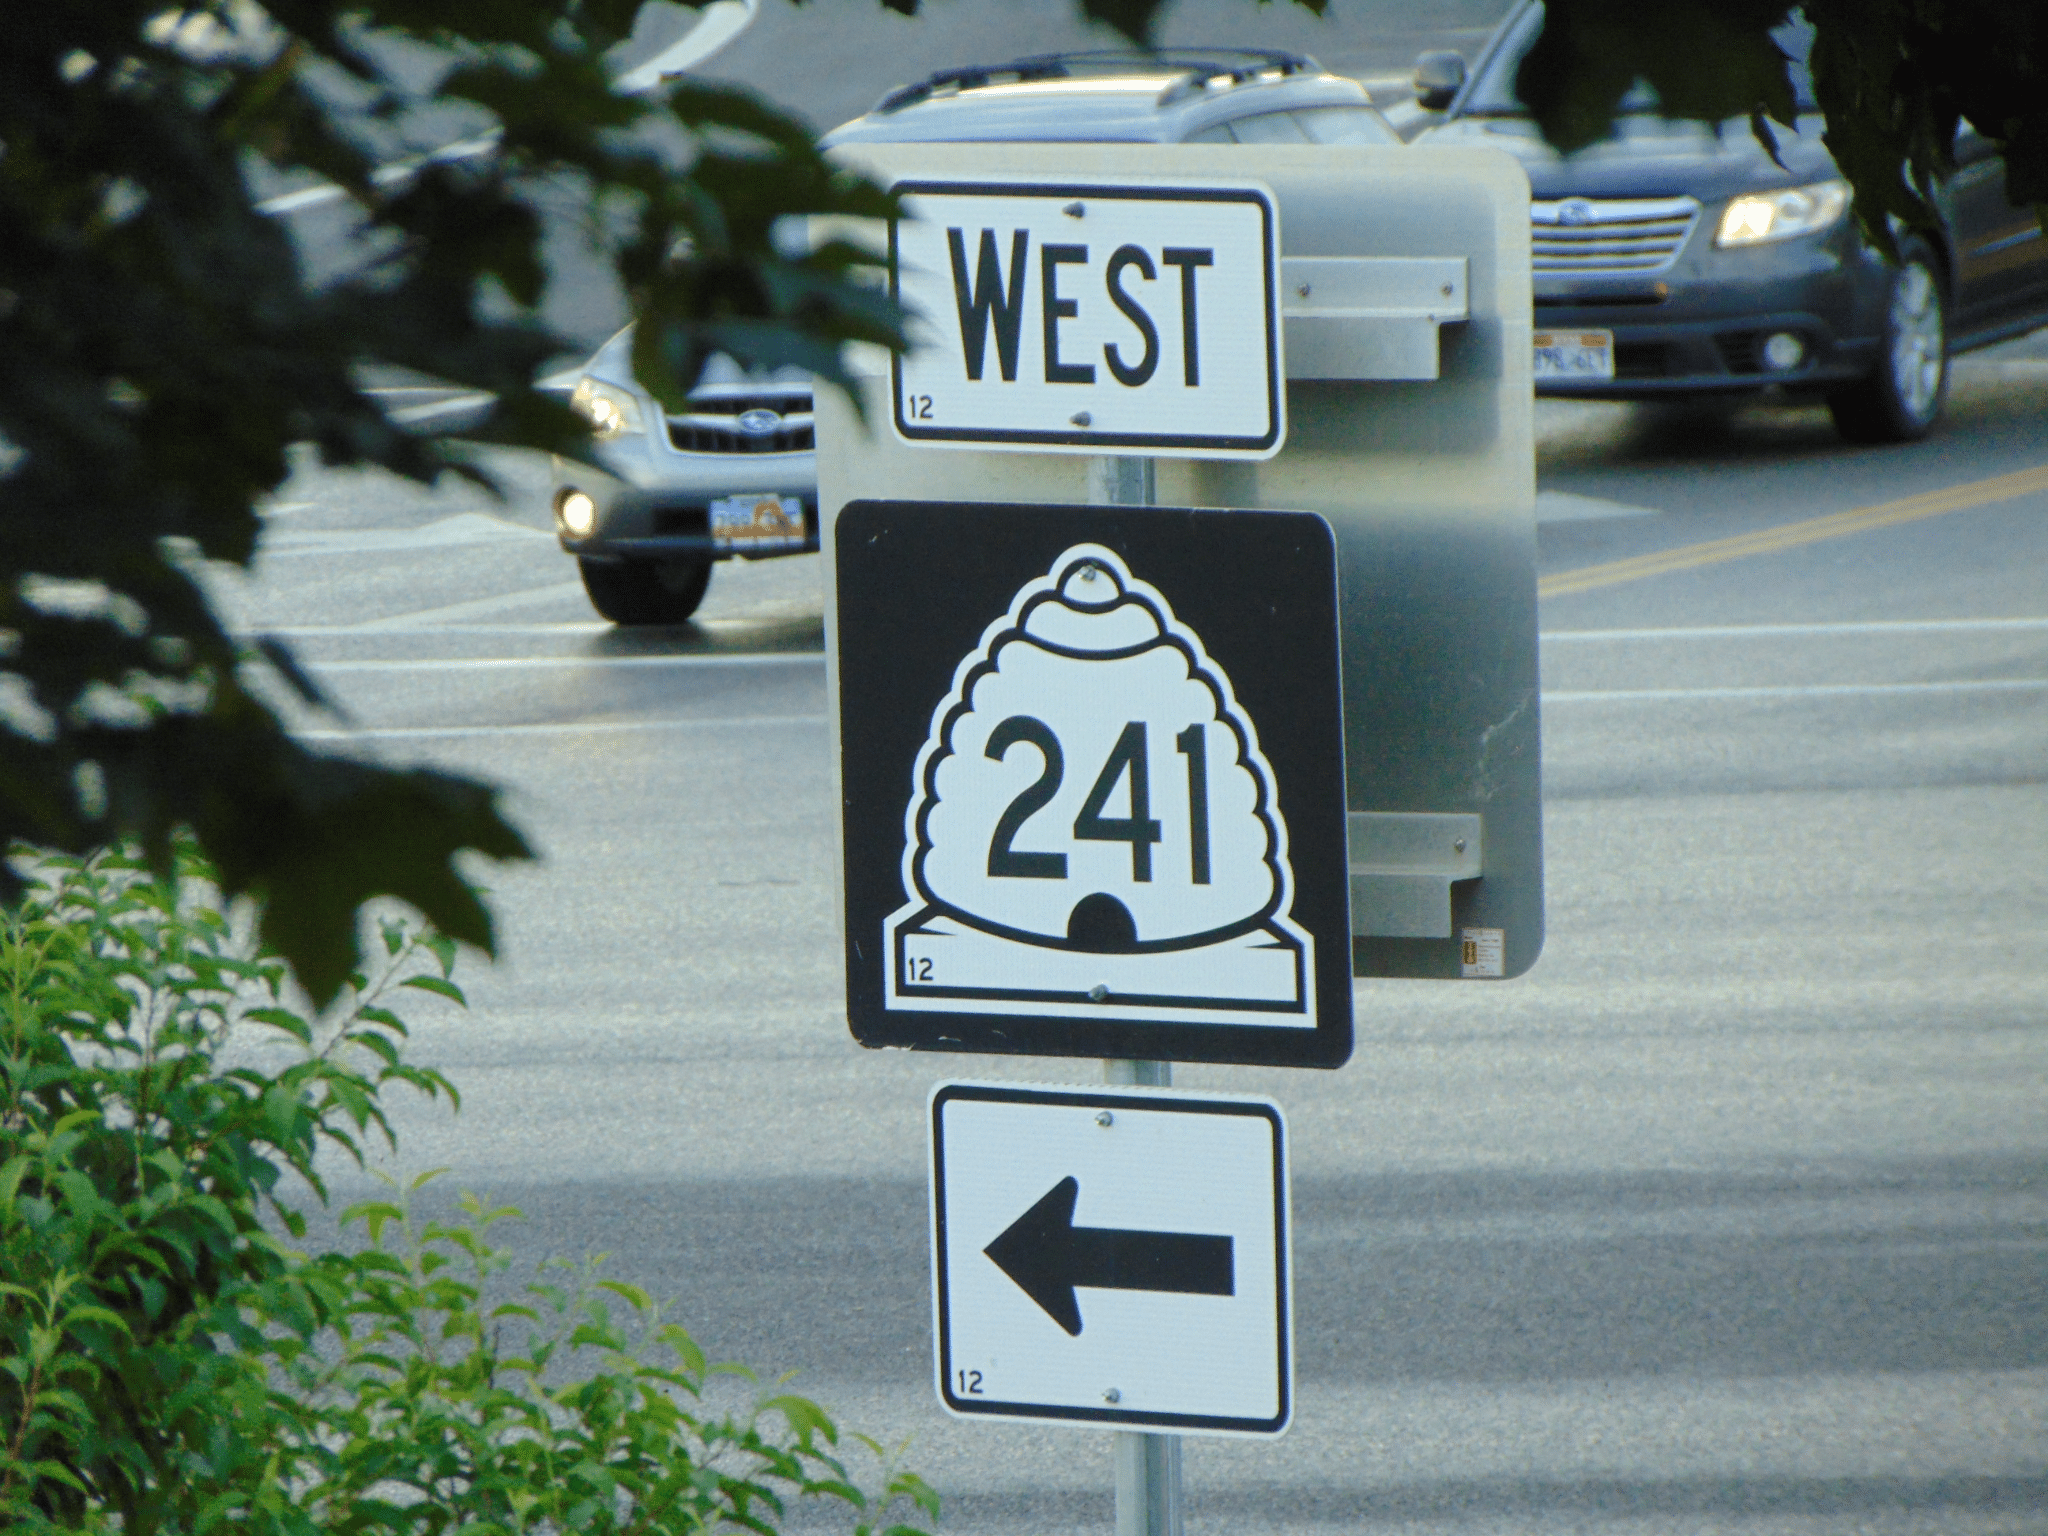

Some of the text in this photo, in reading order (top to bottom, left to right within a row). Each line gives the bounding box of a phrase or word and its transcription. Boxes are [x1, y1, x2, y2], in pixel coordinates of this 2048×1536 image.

[947, 227, 1214, 388] WEST
[909, 395, 934, 419] 12
[984, 715, 1212, 886] 241
[907, 957, 934, 983] 12
[958, 1369, 984, 1395] 12
